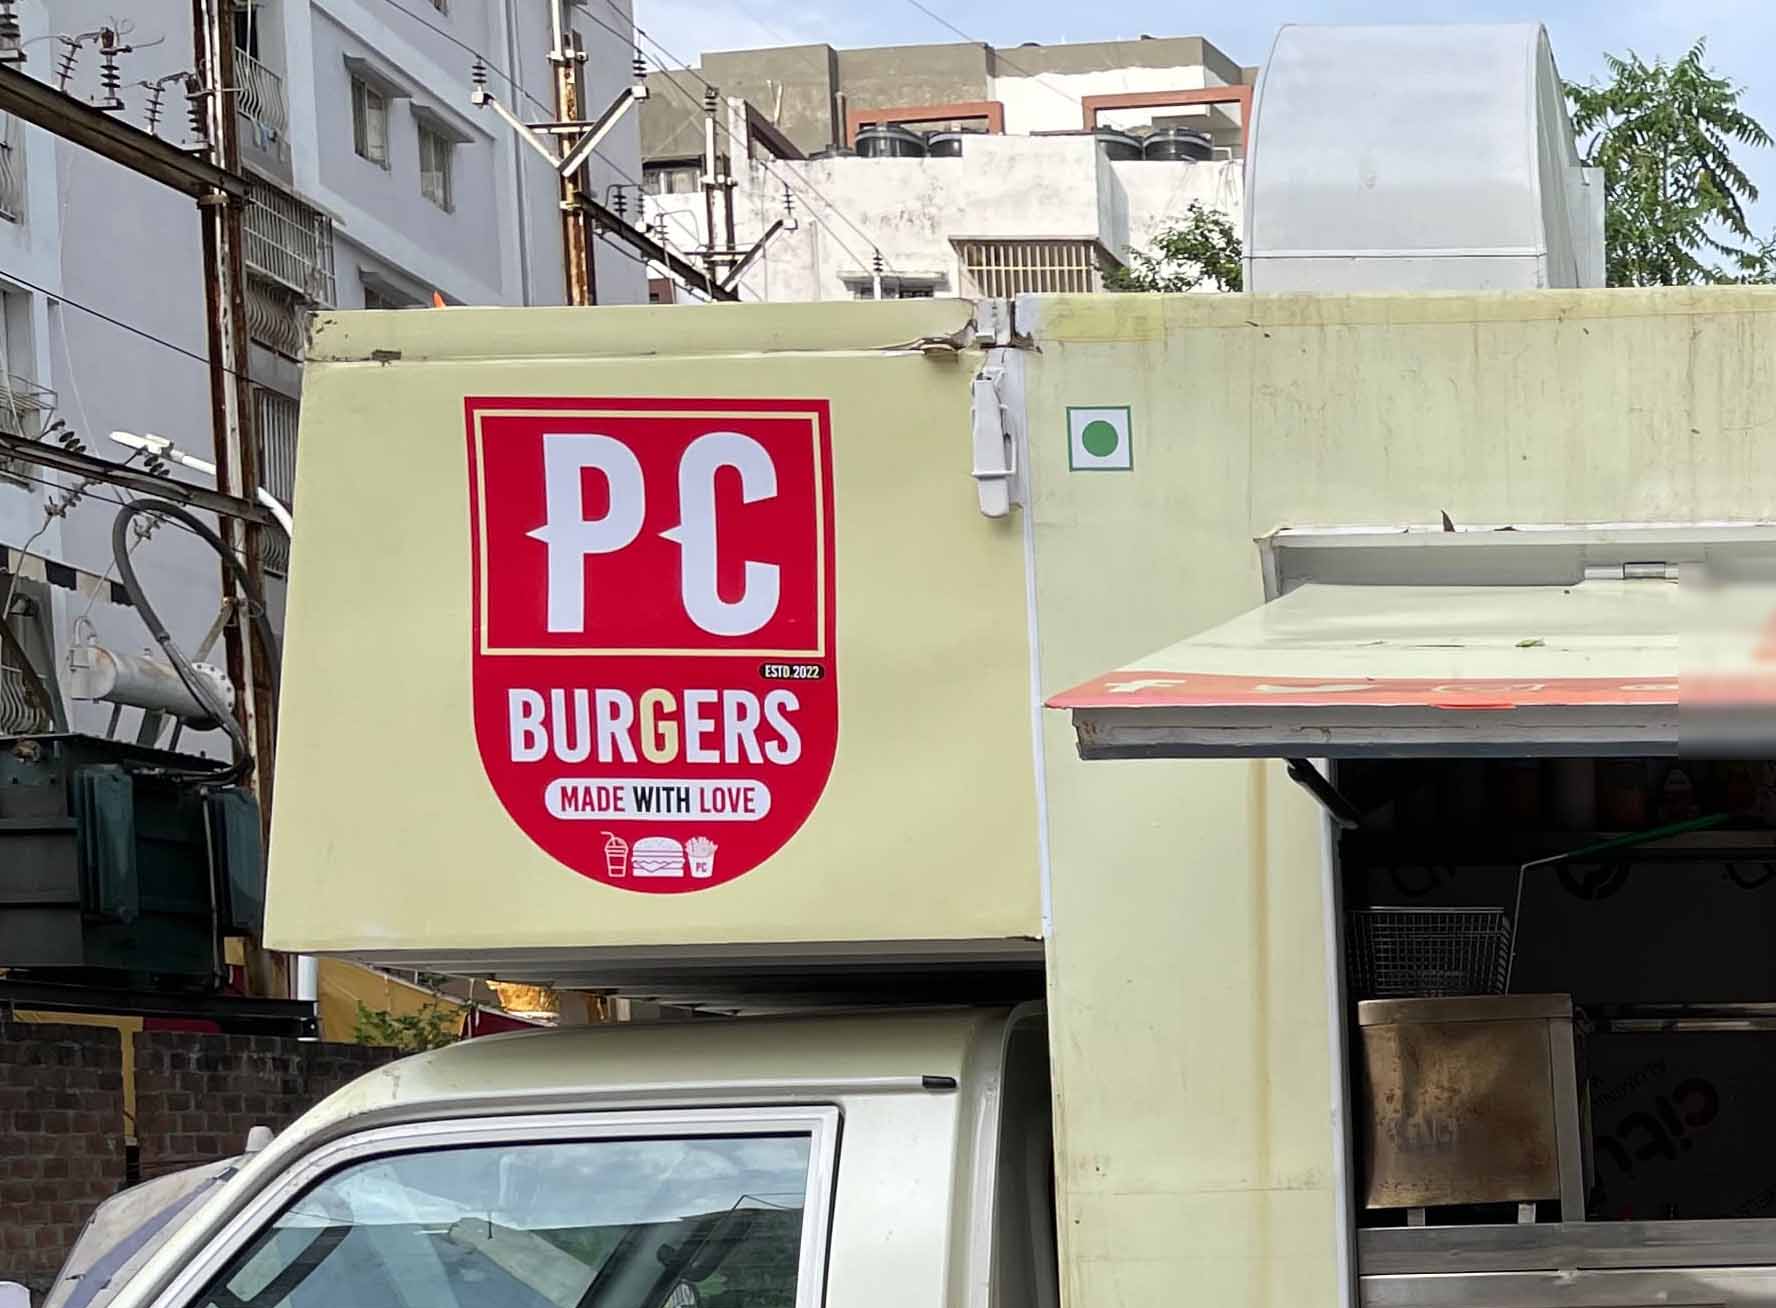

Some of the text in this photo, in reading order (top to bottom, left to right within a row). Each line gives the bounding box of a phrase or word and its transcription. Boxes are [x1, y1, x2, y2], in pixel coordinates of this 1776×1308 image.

[525, 431, 780, 637] PC
[508, 687, 802, 765] BURGERS
[560, 785, 756, 814] MADE WITH LOVE
